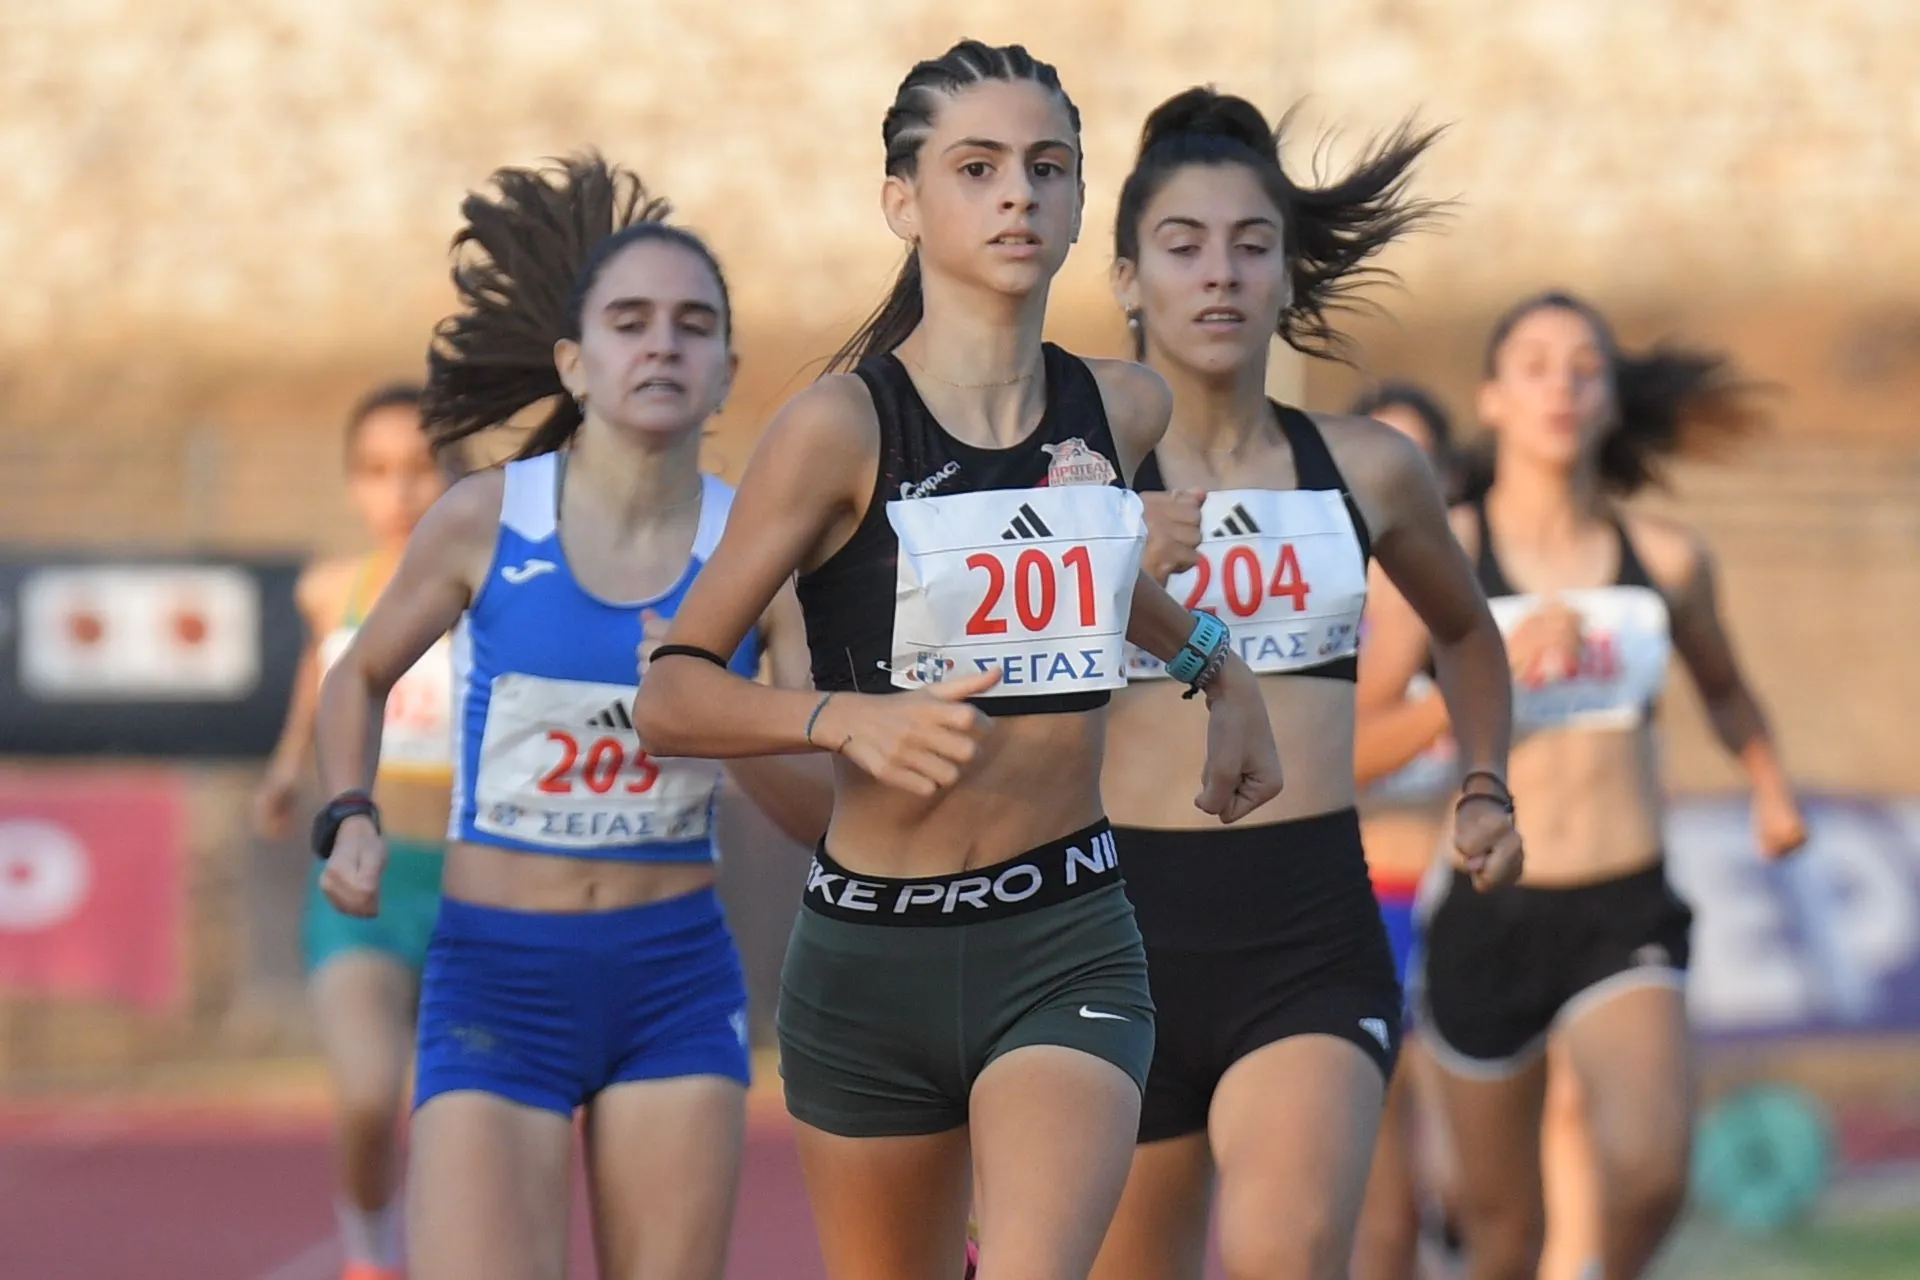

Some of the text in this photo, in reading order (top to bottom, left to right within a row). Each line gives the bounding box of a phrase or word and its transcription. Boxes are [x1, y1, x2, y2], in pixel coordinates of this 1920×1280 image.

[965, 545, 1097, 636] 201
[1184, 543, 1311, 617] 204
[1239, 631, 1309, 662] ΓΑΣ
[537, 729, 662, 794] 205
[540, 811, 656, 837] ΣΕΓΑΣ
[893, 864, 1043, 914] PRO
